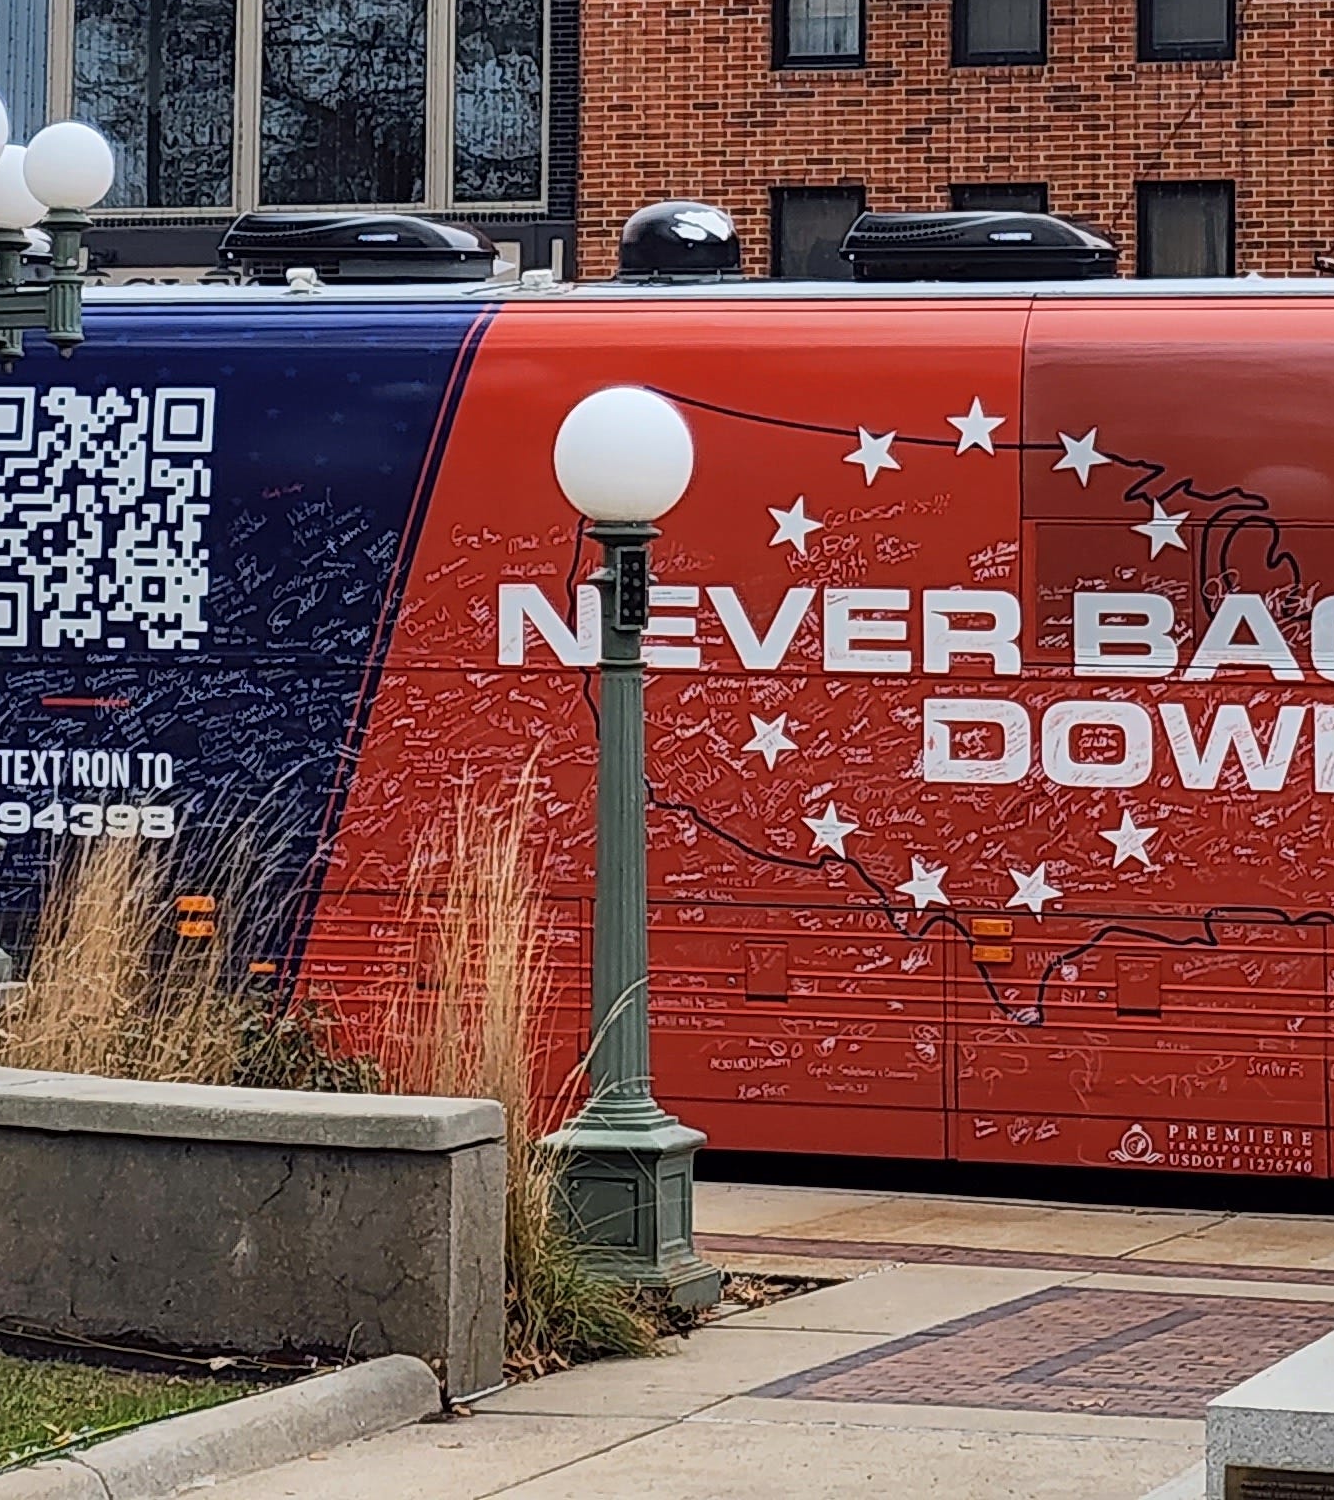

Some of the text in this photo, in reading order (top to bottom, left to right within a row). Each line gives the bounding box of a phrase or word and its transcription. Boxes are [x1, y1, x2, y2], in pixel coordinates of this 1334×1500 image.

[499, 585, 1021, 674] NEVER
[72, 751, 130, 788] RON
[137, 752, 174, 789] TO
[1168, 1124, 1313, 1146] PREMIERE
[1168, 1141, 1313, 1157] TRANSPORTATION
[1169, 1153, 1226, 1169] USDOT
[1249, 1157, 1313, 1174] 1276740
